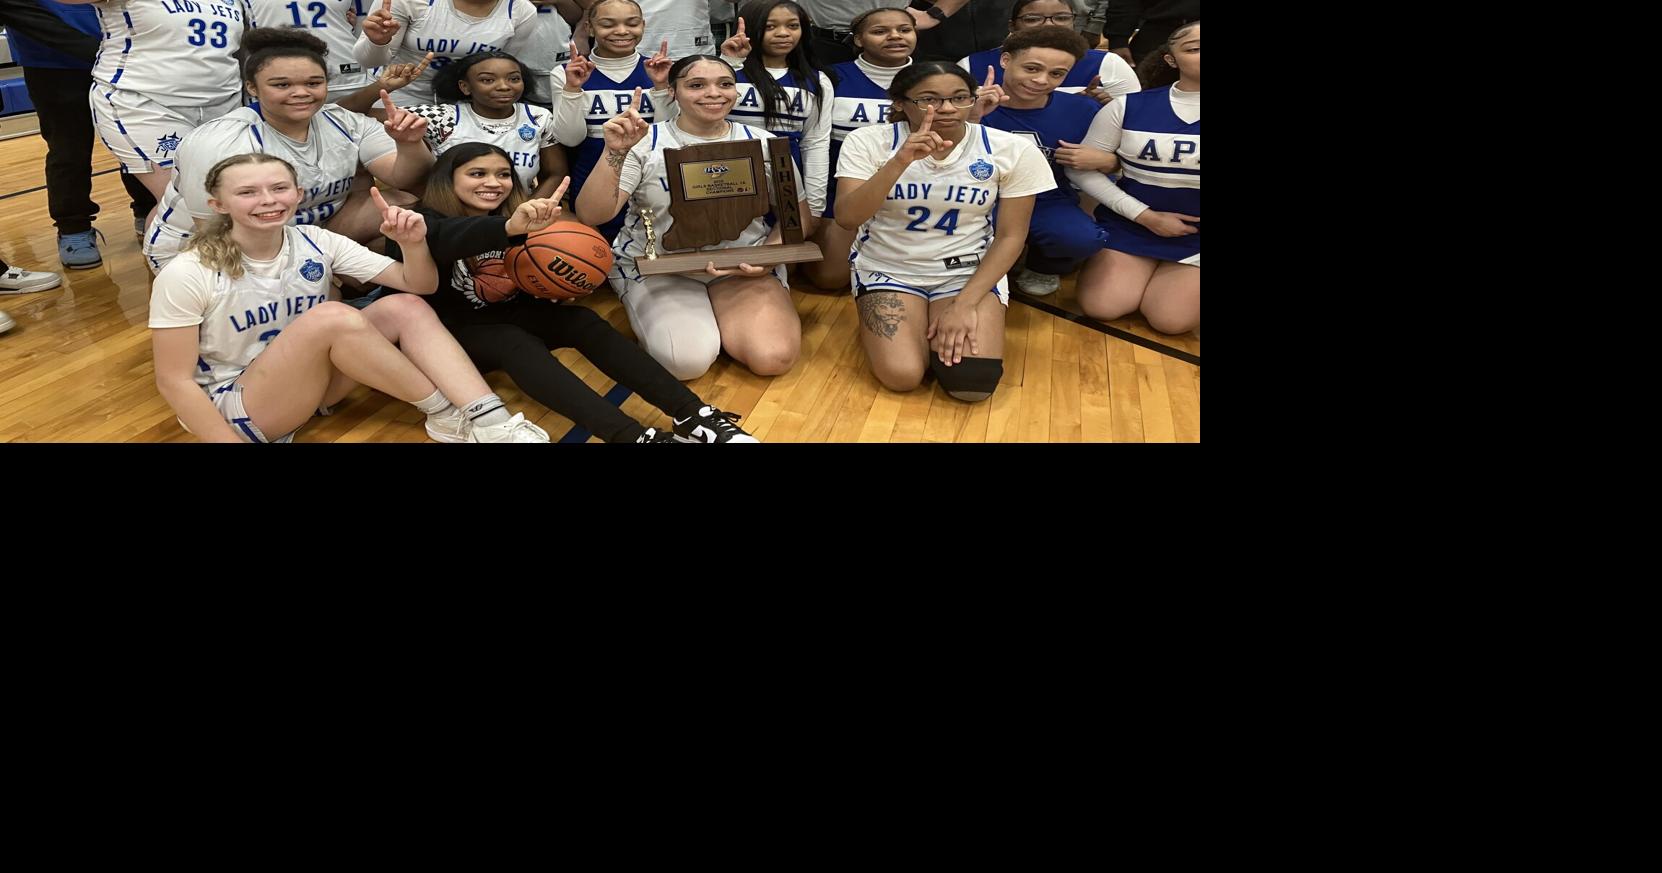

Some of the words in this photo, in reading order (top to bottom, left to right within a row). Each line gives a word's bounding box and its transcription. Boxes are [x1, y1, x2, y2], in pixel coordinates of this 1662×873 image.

[161, 0, 202, 14] LADY
[210, 4, 240, 22] JETS
[286, 1, 328, 28] 12
[187, 18, 228, 49] 33
[416, 37, 460, 54] LADY
[466, 42, 502, 55] JET
[508, 151, 537, 168] ETS
[1137, 139, 1200, 163] AP
[325, 177, 354, 198] JETS
[944, 185, 990, 206] JETS
[905, 205, 961, 236] 24
[547, 256, 596, 290] Wilso
[229, 301, 279, 333] LADY
